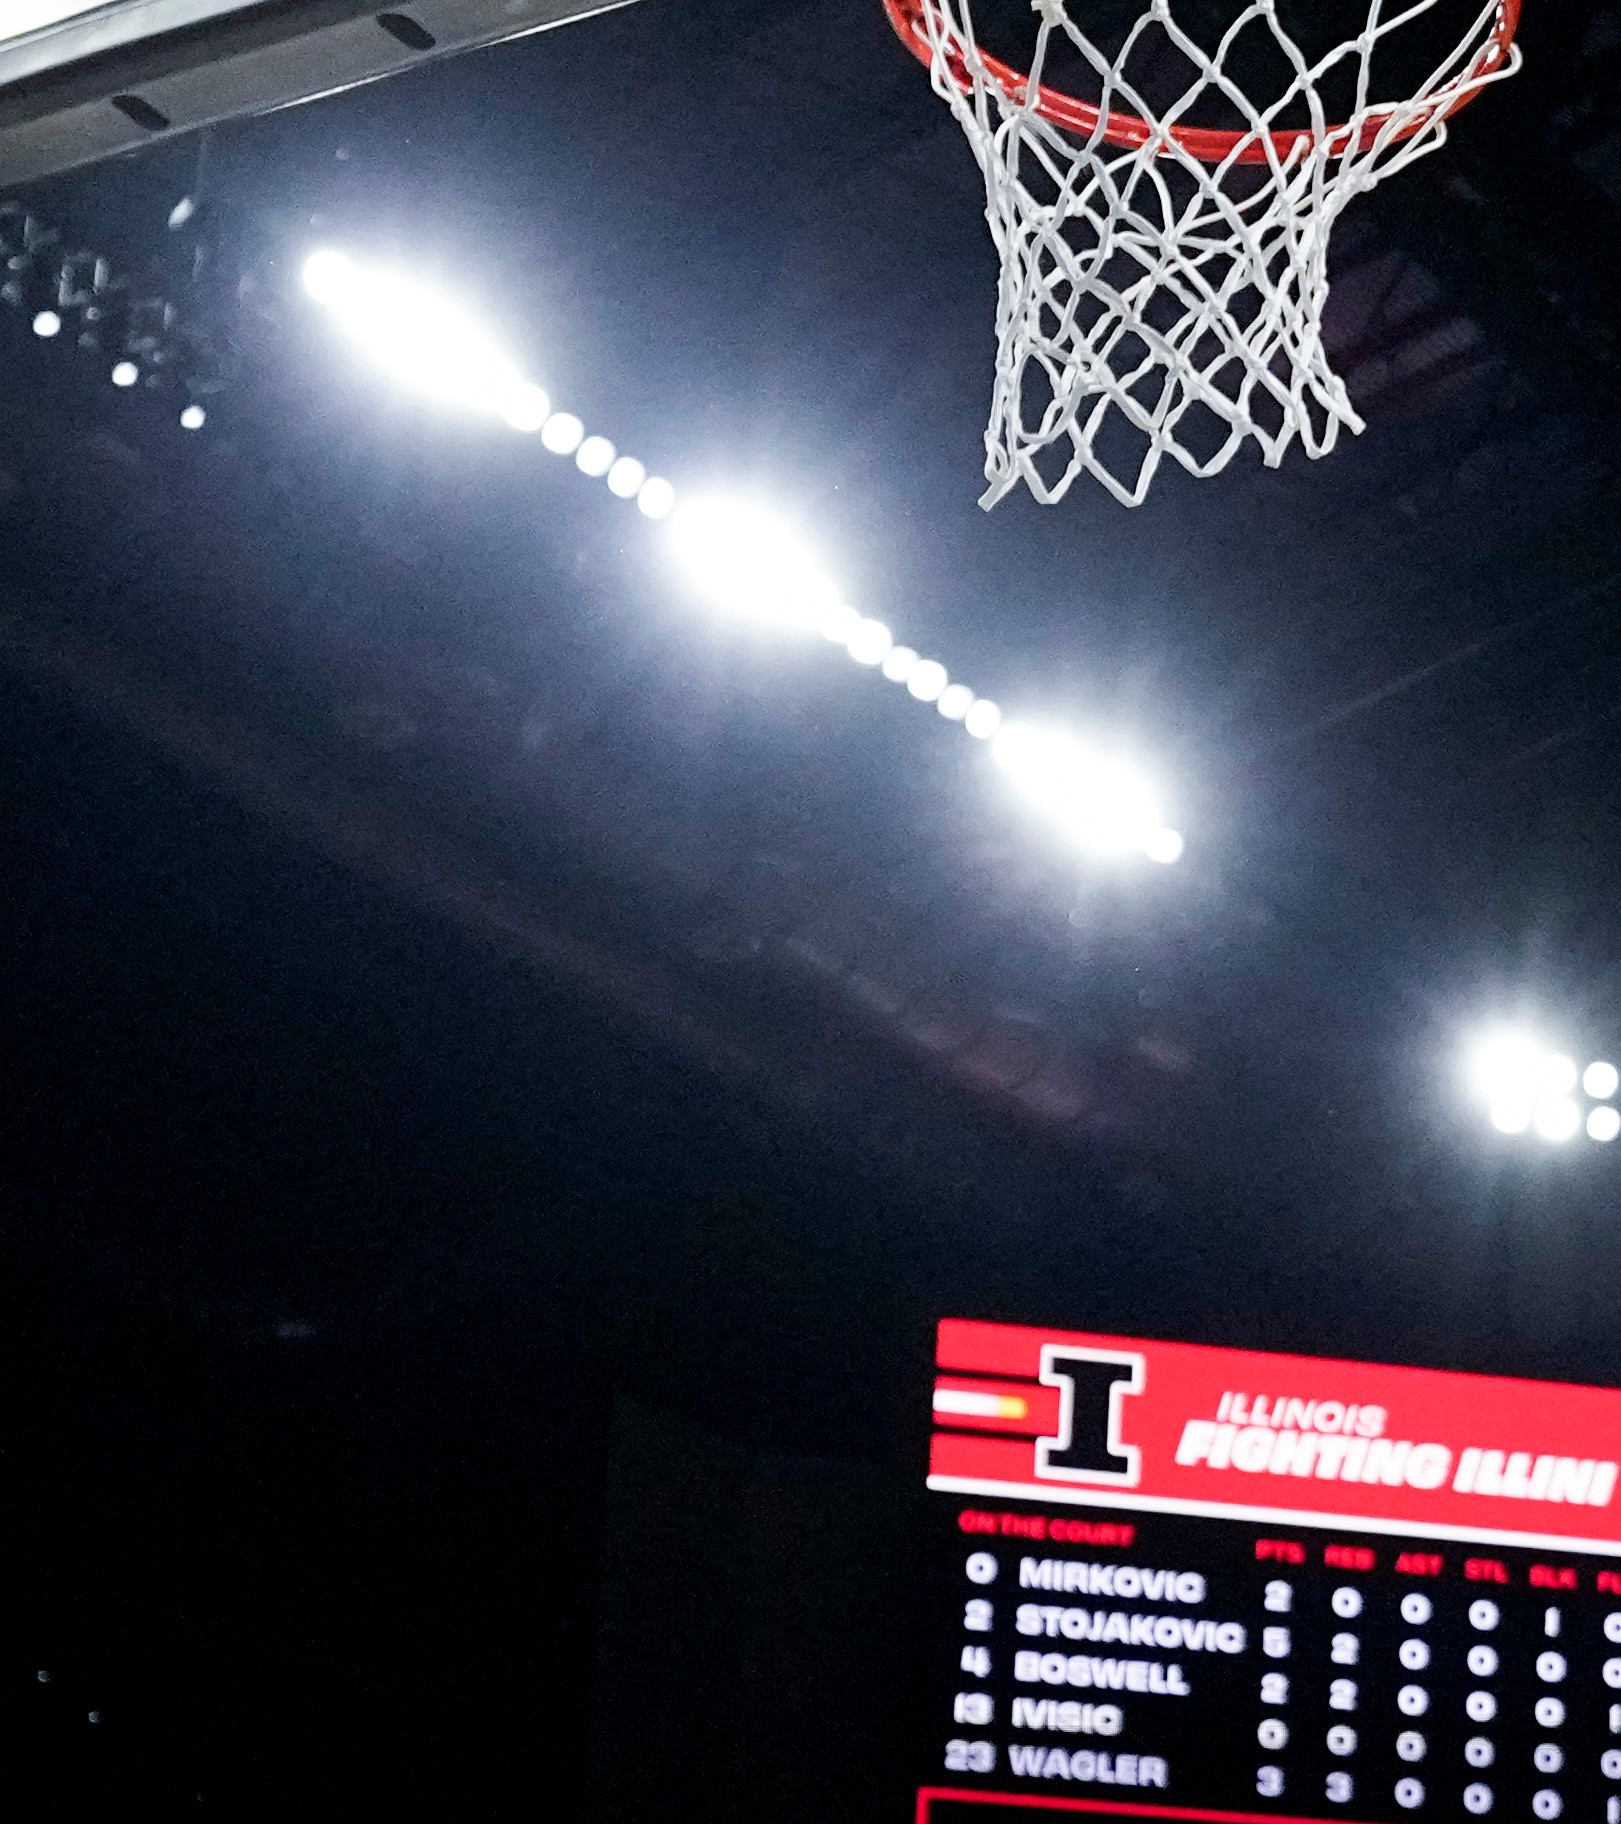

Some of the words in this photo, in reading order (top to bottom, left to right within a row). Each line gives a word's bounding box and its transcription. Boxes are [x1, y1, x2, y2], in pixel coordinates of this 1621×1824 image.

[1216, 1391, 1387, 1437] ILLINOIS
[1175, 1418, 1452, 1489] FIGHTING
[1453, 1445, 1619, 1507] ILLINI
[965, 1552, 998, 1585] 0
[1019, 1556, 1207, 1604] MIRKOVIC
[1264, 1579, 1293, 1613] 2
[1331, 1586, 1363, 1619] 0
[1401, 1592, 1433, 1625] 0
[1469, 1599, 1500, 1631] 0
[1395, 1552, 1444, 1577] AST
[963, 1598, 994, 1632] 2
[1015, 1602, 1248, 1655] STOJAKOVIC
[1262, 1626, 1292, 1659] 5
[1331, 1632, 1360, 1665] 2
[1398, 1638, 1431, 1671] 0
[1467, 1644, 1499, 1677] 0
[1536, 1651, 1567, 1683] 0
[960, 1645, 991, 1678] 4
[1014, 1649, 1191, 1697] BOSWELL
[1261, 1672, 1290, 1705] 2
[1329, 1678, 1359, 1711] 2
[1397, 1684, 1429, 1717] 0
[1466, 1690, 1497, 1722] 0
[1535, 1696, 1566, 1728] 0
[953, 1692, 994, 1725] 13
[1011, 1697, 1124, 1737] IVISIC
[1257, 1718, 1289, 1751] 0
[1326, 1724, 1358, 1757] 0
[1396, 1730, 1427, 1763] 0
[1464, 1736, 1495, 1768] 0
[1534, 1742, 1565, 1774] 0
[944, 1739, 997, 1774] 23
[1008, 1745, 1169, 1789] WAGLER
[1256, 1765, 1285, 1798] 3
[1325, 1771, 1354, 1803] 3
[1394, 1776, 1426, 1809] 0
[1463, 1782, 1494, 1815] 0
[1532, 1788, 1563, 1821] 0
